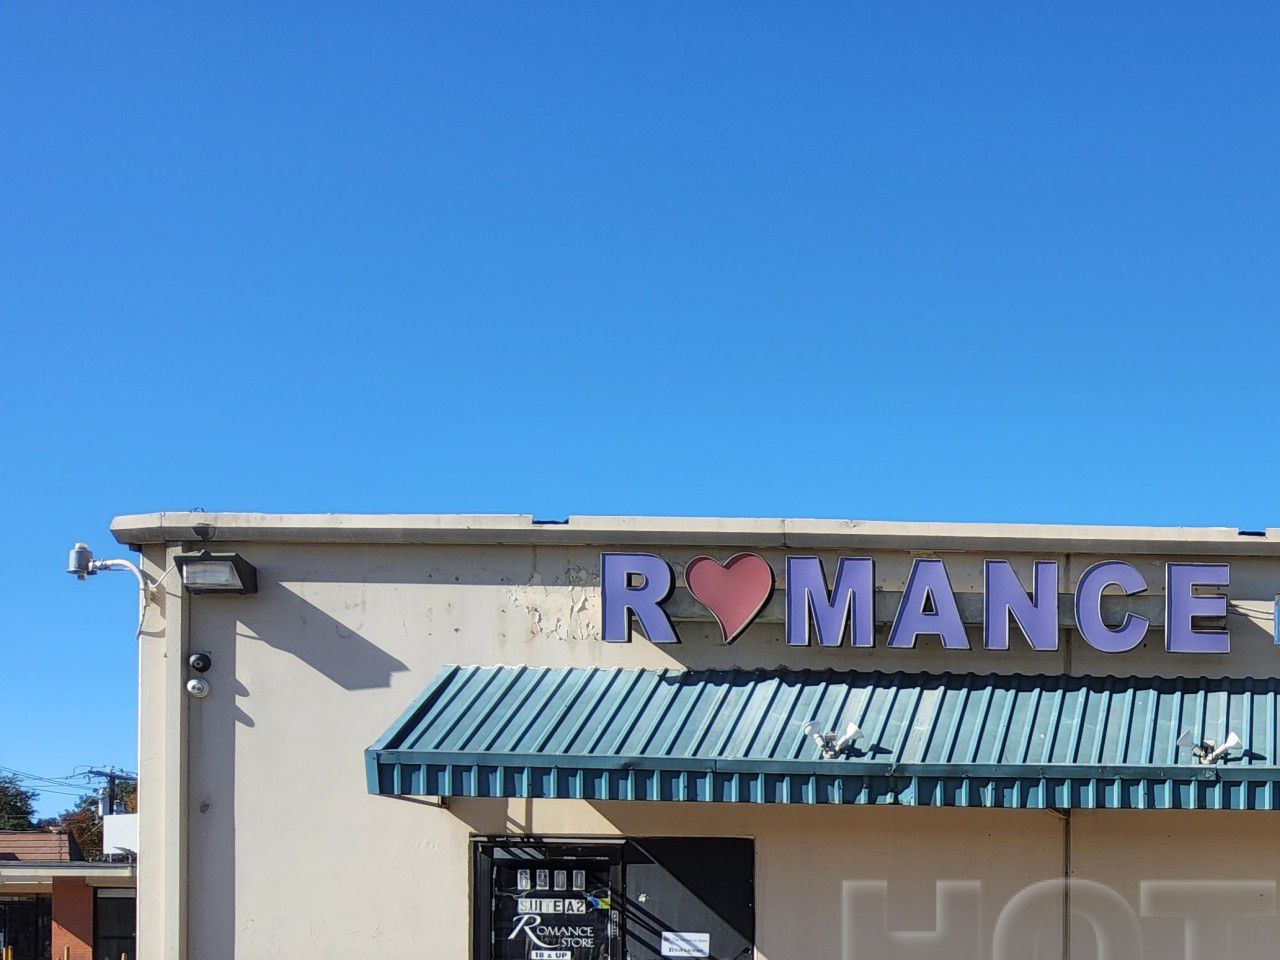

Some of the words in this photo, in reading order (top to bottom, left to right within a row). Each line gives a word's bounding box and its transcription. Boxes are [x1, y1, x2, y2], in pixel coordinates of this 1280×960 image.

[602, 552, 1231, 656] RMANCE
[518, 869, 586, 891] 6900
[519, 899, 563, 913] SUITE
[565, 899, 586, 914] A2
[508, 914, 595, 948] ROMANCE
[561, 938, 595, 948] STORE
